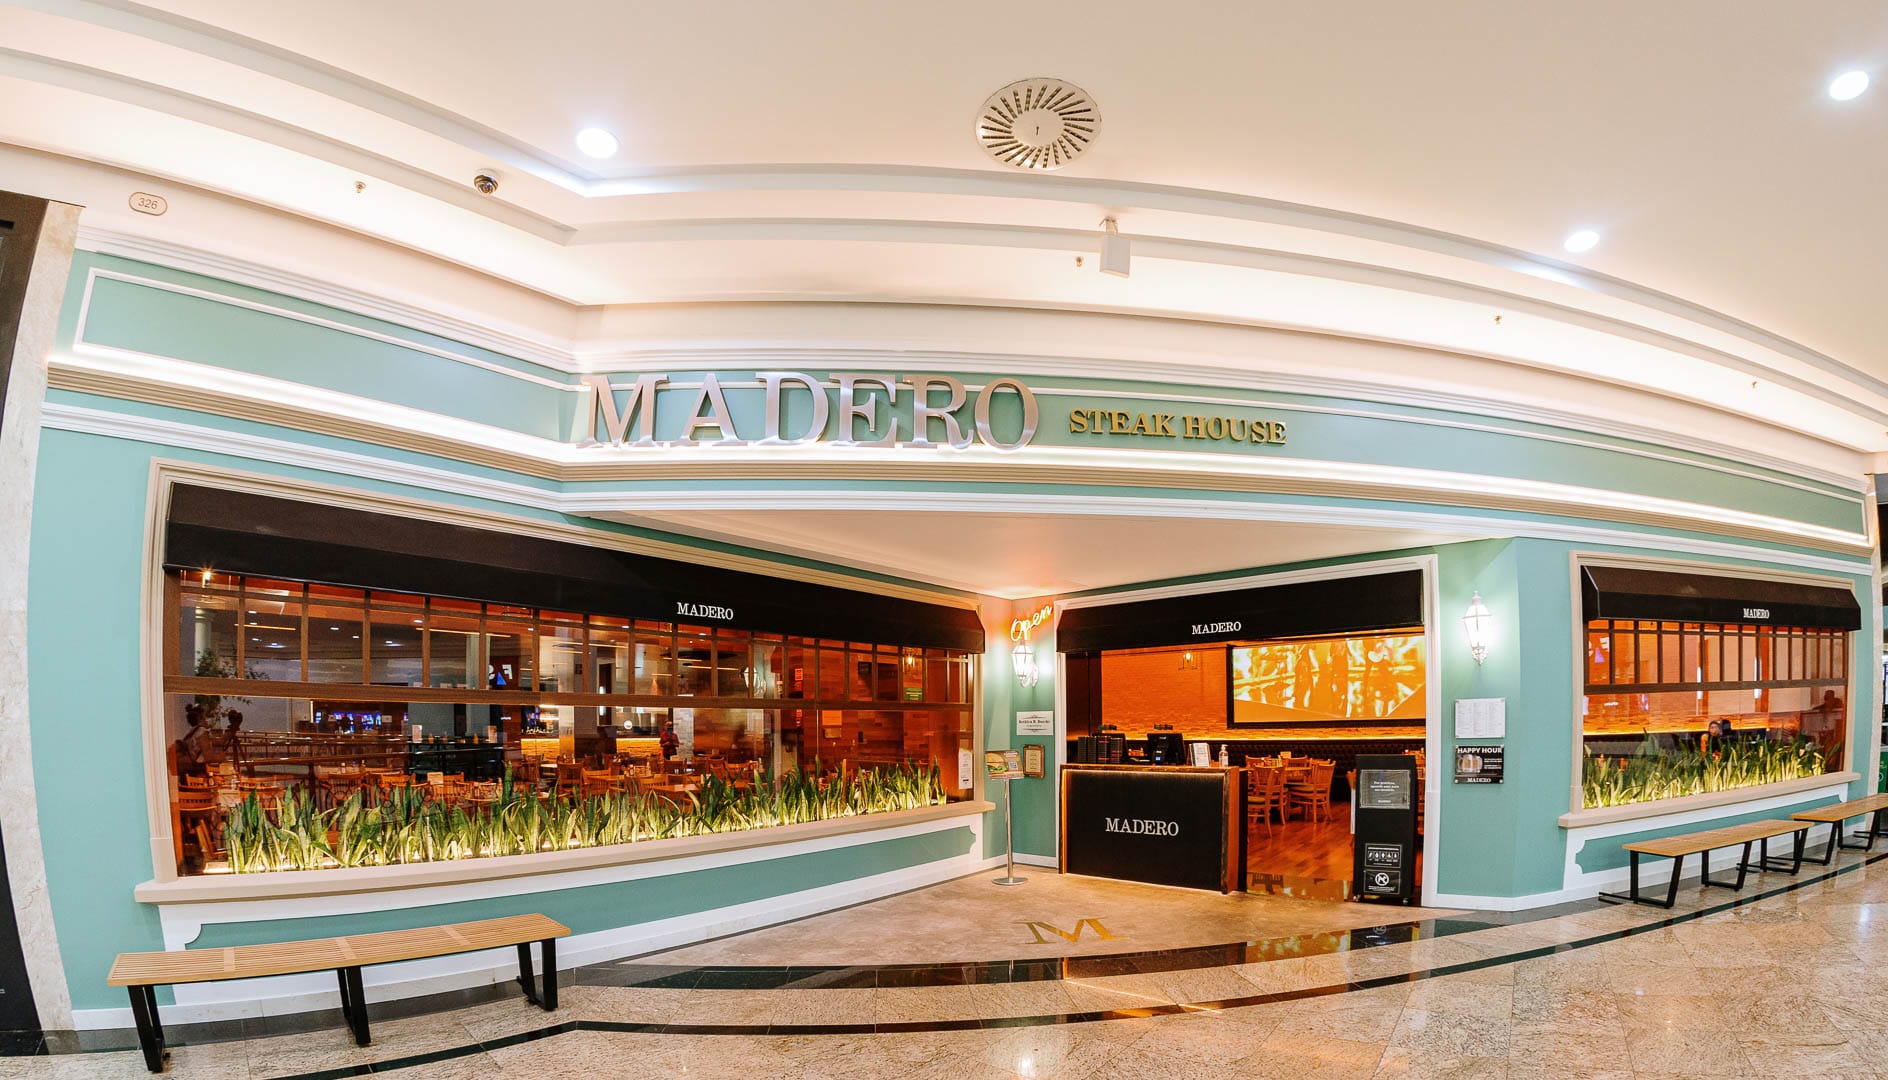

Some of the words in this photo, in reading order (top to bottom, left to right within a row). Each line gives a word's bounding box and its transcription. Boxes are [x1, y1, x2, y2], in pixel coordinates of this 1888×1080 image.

[138, 197, 158, 210] 326
[576, 371, 1040, 450] MADERO
[1069, 408, 1177, 437] STEAK
[1182, 415, 1289, 444] HOUSE
[676, 601, 734, 621] MADERO
[1743, 607, 1770, 619] MADERO
[1010, 604, 1054, 642] Open
[1191, 620, 1242, 635] MADERO
[1105, 817, 1180, 837] MADERO
